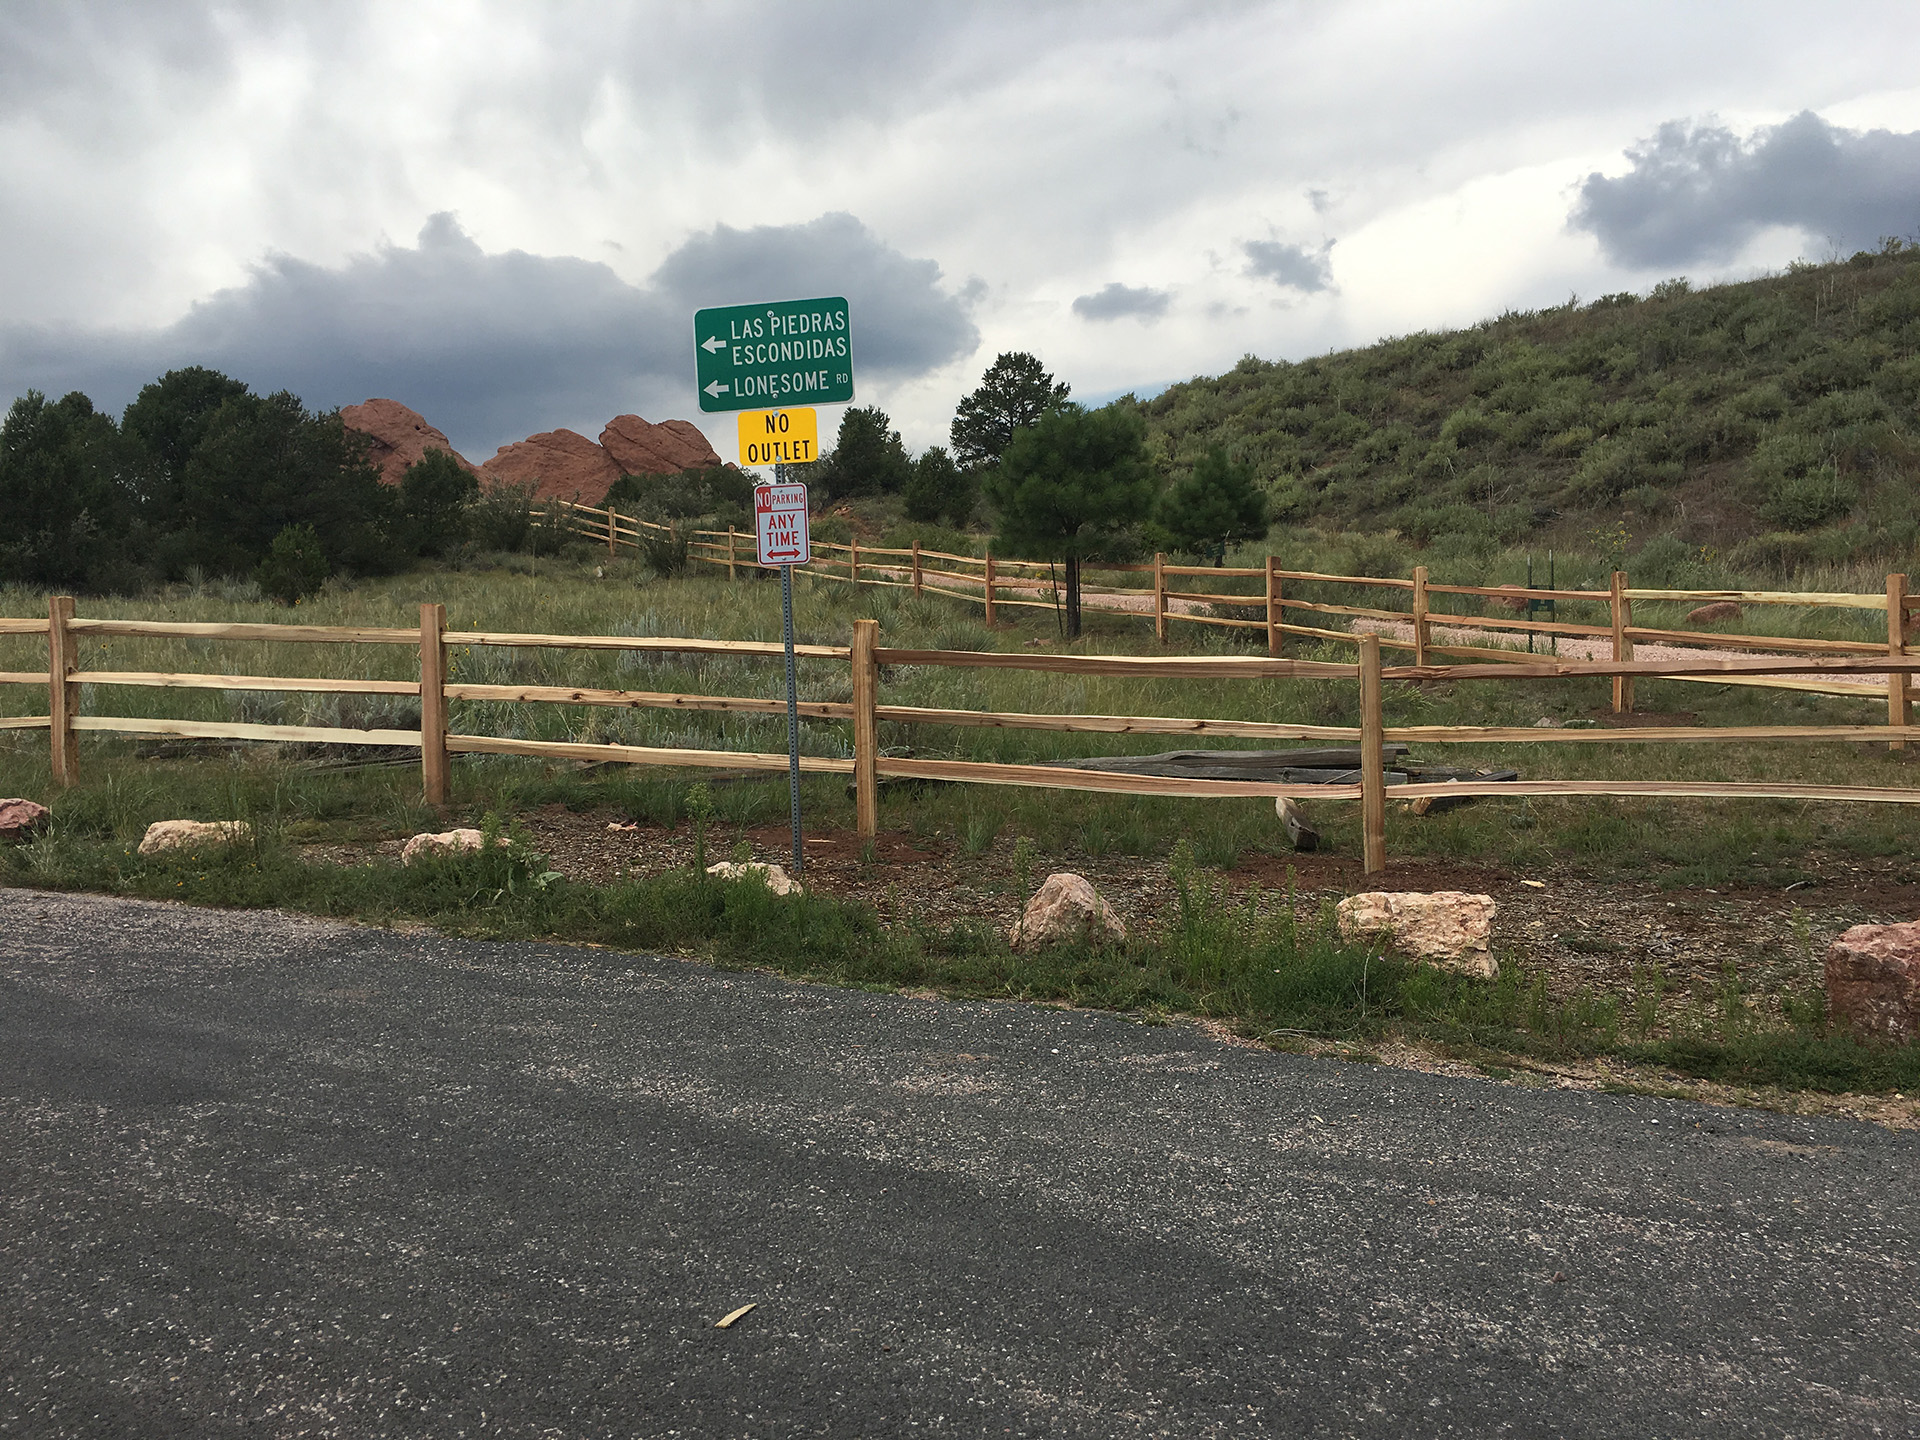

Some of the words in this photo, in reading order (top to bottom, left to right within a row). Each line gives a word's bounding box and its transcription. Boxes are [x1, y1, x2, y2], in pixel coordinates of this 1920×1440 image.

[731, 318, 763, 340] LAS
[770, 311, 846, 336] PIEDRAS
[732, 337, 847, 366] ESCONDIDAS
[734, 370, 829, 397] LONESOME
[836, 373, 848, 384] RD
[765, 413, 789, 434] NO
[748, 440, 810, 463] OUTLET
[757, 492, 771, 508] NO
[772, 493, 804, 506] PARKING
[768, 514, 796, 530] ANY
[766, 530, 800, 547] TIME
